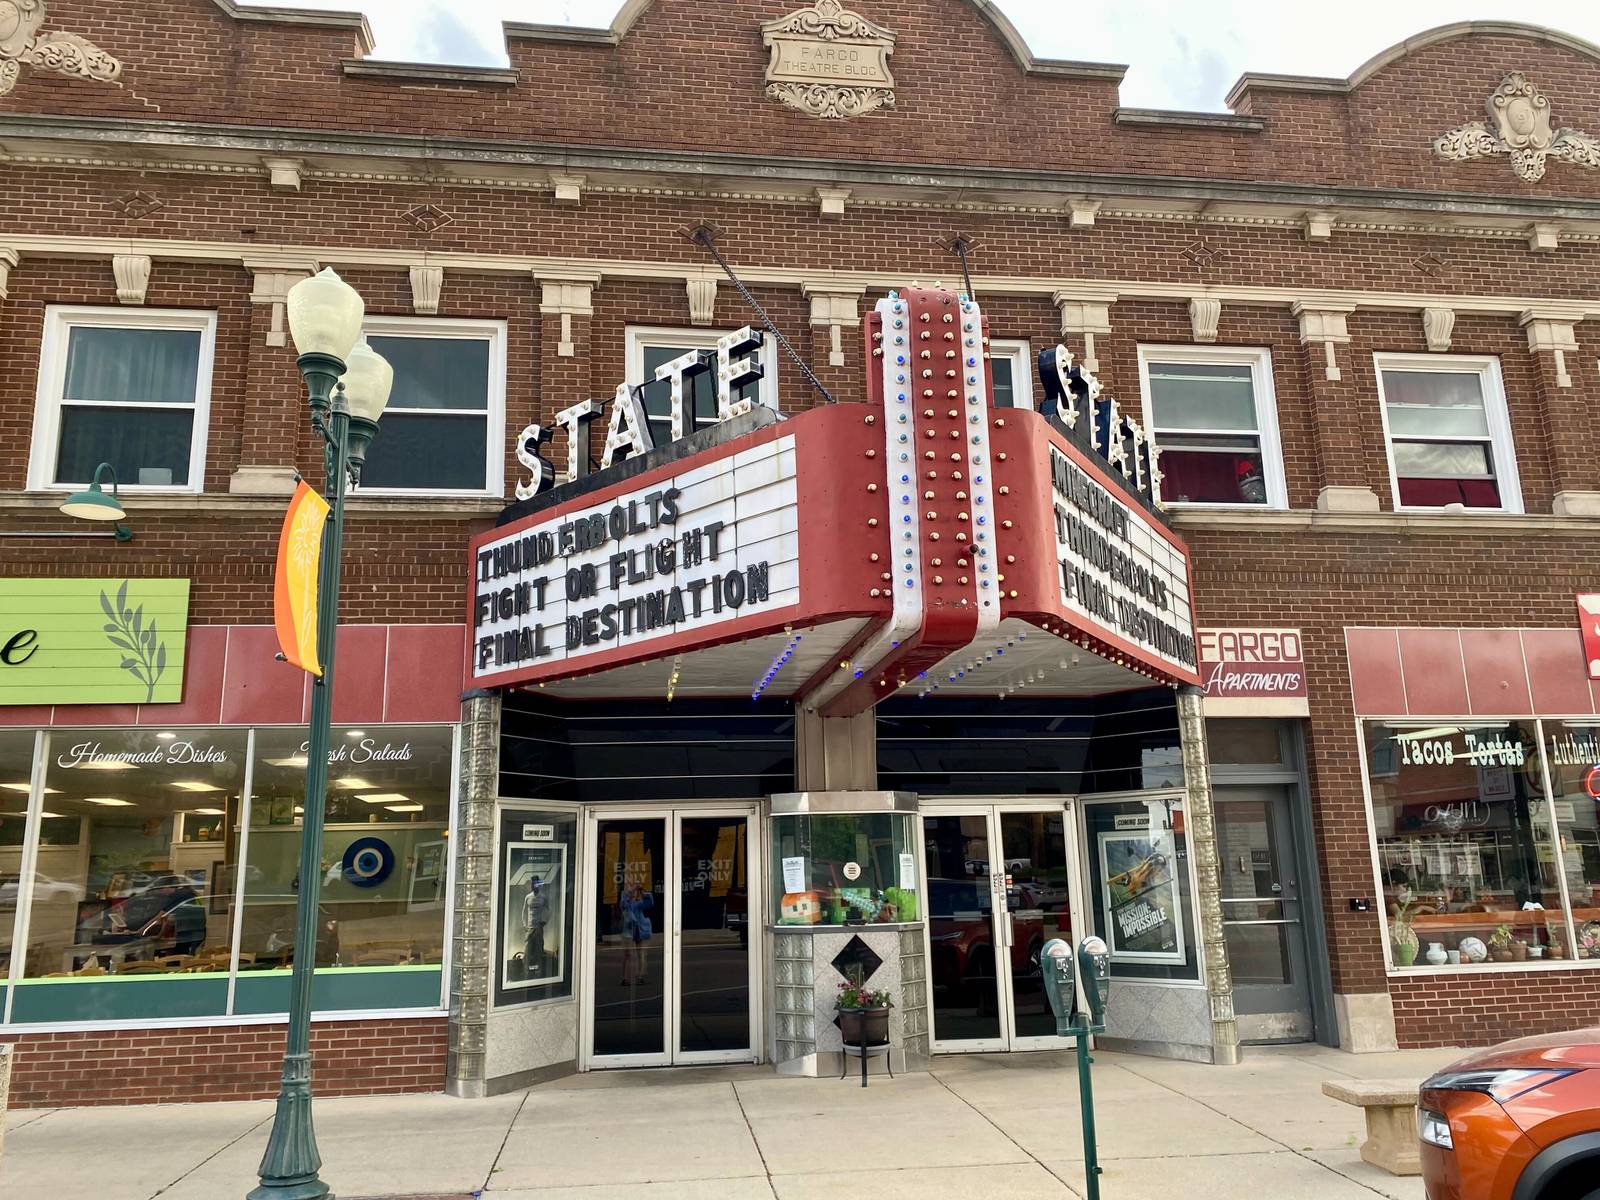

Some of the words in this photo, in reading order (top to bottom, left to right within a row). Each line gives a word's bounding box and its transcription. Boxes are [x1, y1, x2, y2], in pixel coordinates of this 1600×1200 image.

[783, 60, 840, 74] THEATRE
[801, 47, 859, 62] FARGO
[515, 324, 764, 501] STATE
[1051, 448, 1129, 543] MINECRAFT
[1054, 502, 1169, 612] THUNDERBOLTS
[474, 575, 548, 628] FIGHT
[564, 562, 598, 602] OR
[609, 520, 724, 591] FLIGHT
[478, 622, 552, 670] FINAL
[565, 560, 770, 651] DESTINATION
[1062, 557, 1116, 625] FINAL
[1117, 594, 1197, 668] DESTINATION
[1197, 631, 1301, 662] FARGO
[57, 741, 164, 768] Homemade
[166, 741, 228, 765] Dishes
[350, 738, 413, 764] Salads
[1397, 733, 1454, 766] Tacos
[1465, 732, 1525, 766] Tortas
[1117, 818, 1136, 826] COMING
[1137, 817, 1150, 826] SOON
[613, 861, 649, 873] EXIT
[613, 872, 648, 885] ONLY
[697, 860, 734, 871] EXIT
[697, 871, 732, 882] ONLY
[1122, 907, 1168, 939] IMPOSSIBLE
